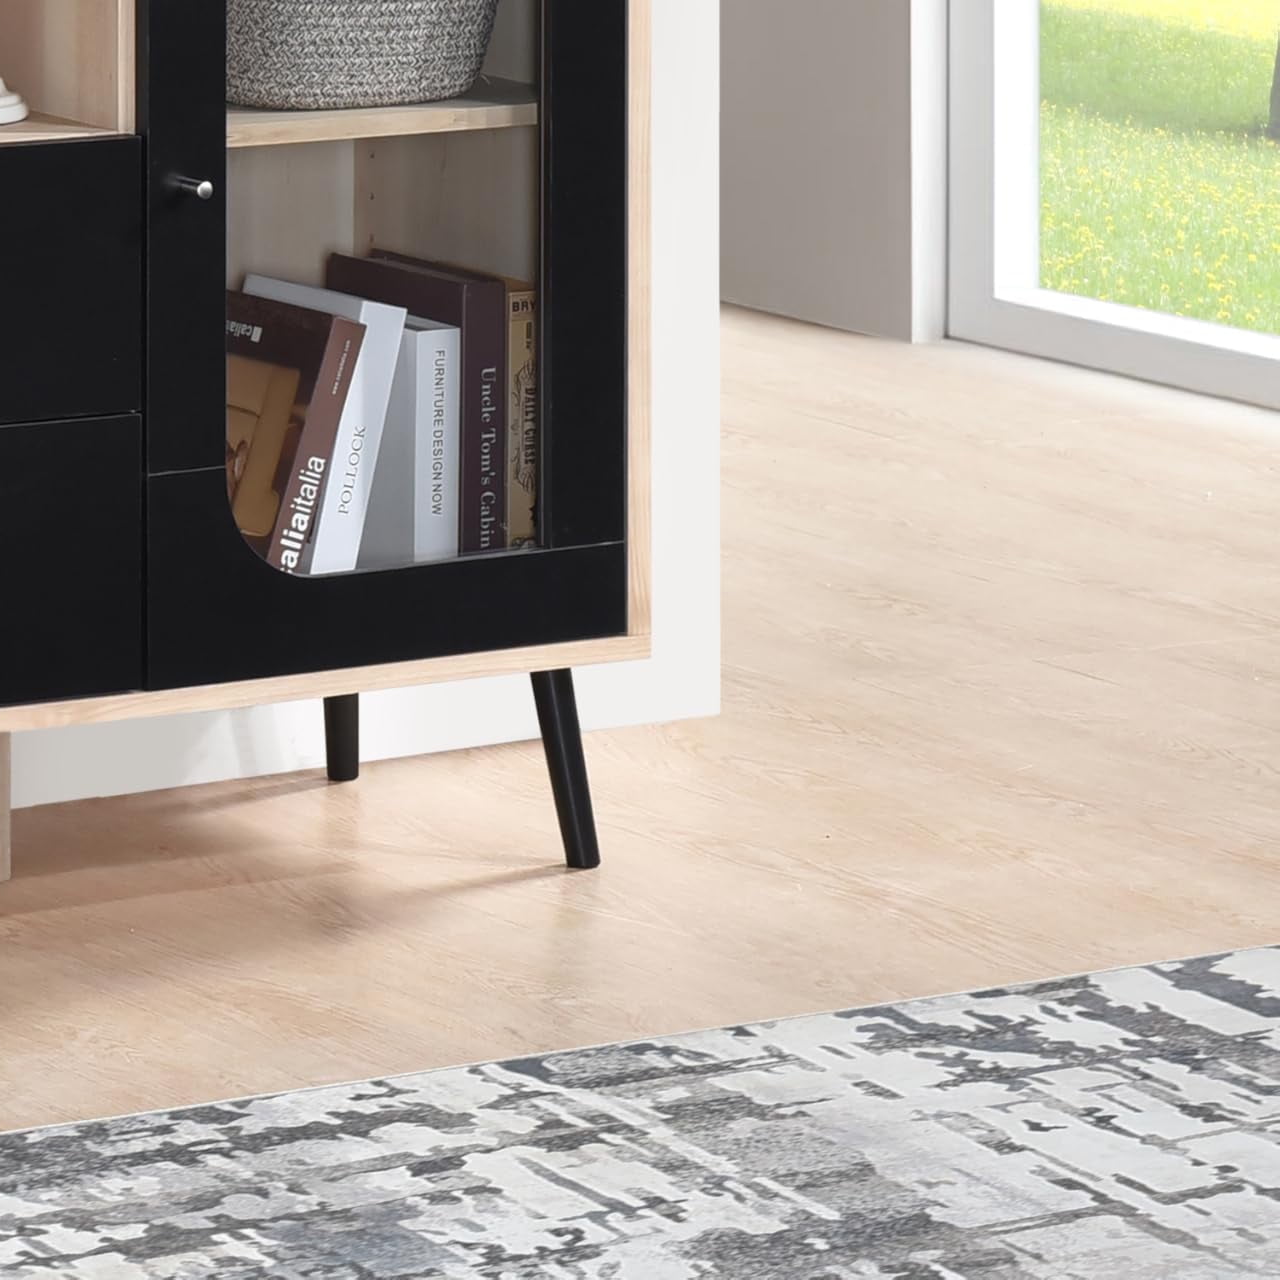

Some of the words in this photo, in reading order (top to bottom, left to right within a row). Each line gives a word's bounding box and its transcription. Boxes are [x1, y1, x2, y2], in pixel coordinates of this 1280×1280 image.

[435, 349, 446, 427] FURNITURE
[481, 367, 497, 424] Uncle
[337, 425, 366, 515] POLLOCK
[433, 429, 445, 479] DESIGN
[481, 430, 497, 486] Tom's
[432, 480, 443, 516] NOW
[480, 491, 497, 549] Cabin
